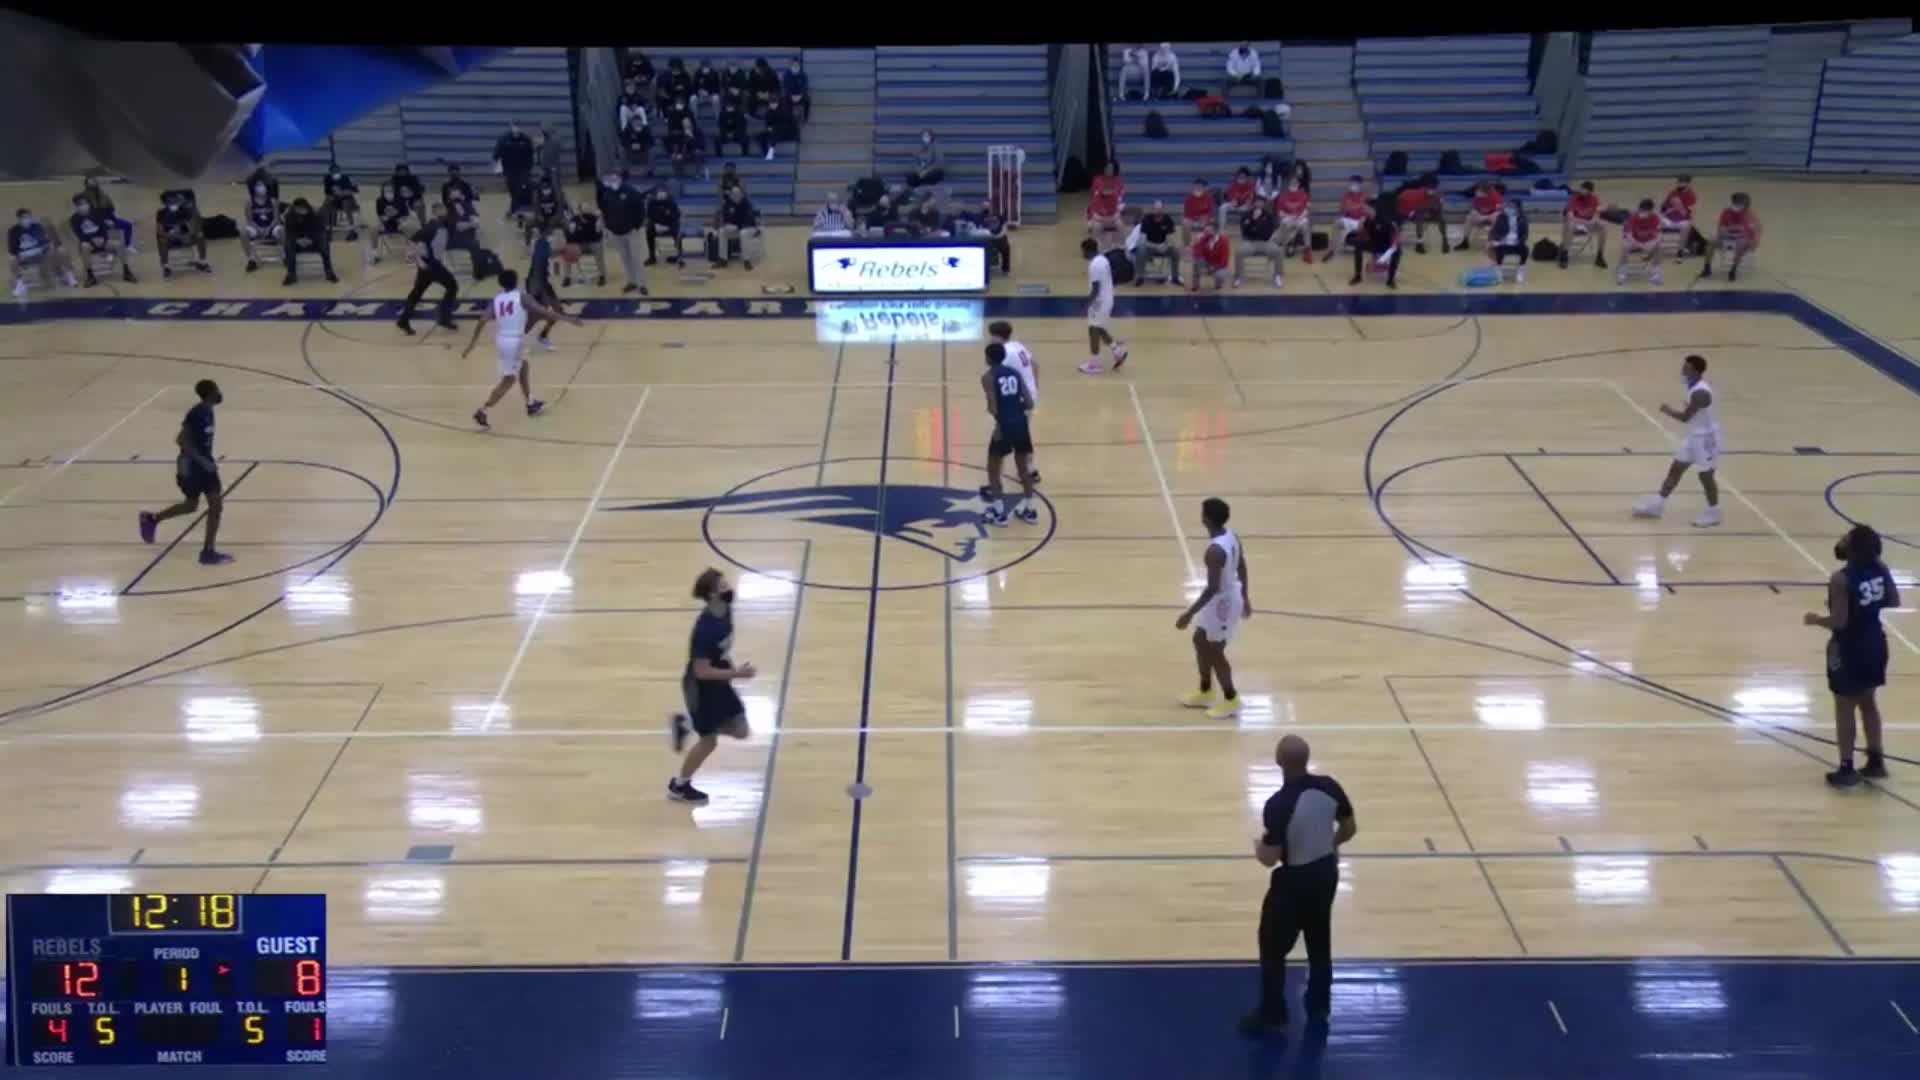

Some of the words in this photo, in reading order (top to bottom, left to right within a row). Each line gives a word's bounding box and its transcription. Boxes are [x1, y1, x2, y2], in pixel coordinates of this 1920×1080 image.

[858, 260, 939, 278] Rebels
[500, 301, 514, 316] 14
[998, 376, 1018, 396] 20
[1859, 576, 1885, 606] 35
